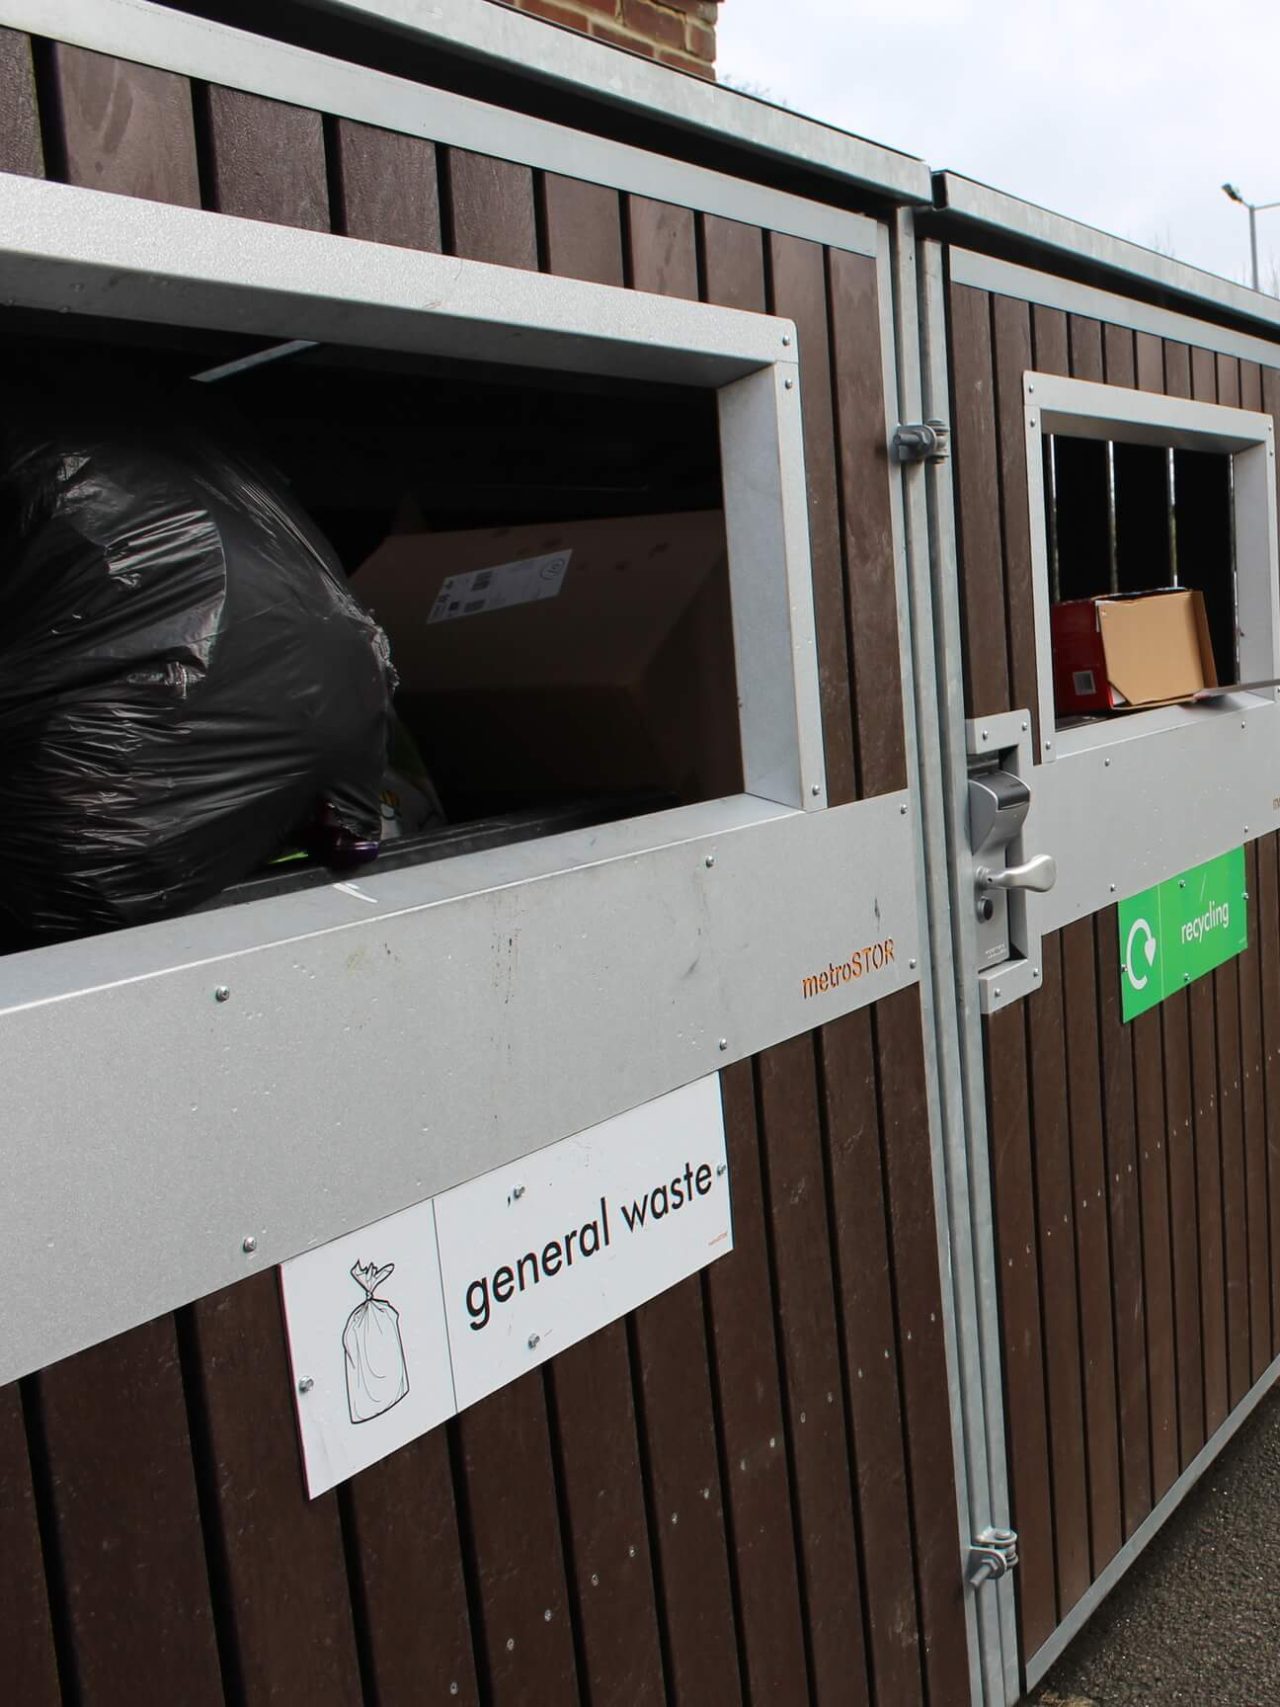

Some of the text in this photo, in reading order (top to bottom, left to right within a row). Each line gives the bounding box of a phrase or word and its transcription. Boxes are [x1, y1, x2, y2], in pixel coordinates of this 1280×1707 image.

[1181, 900, 1230, 944] recycling
[802, 938, 895, 1000] metroSTOR
[465, 1162, 713, 1331] general waste
